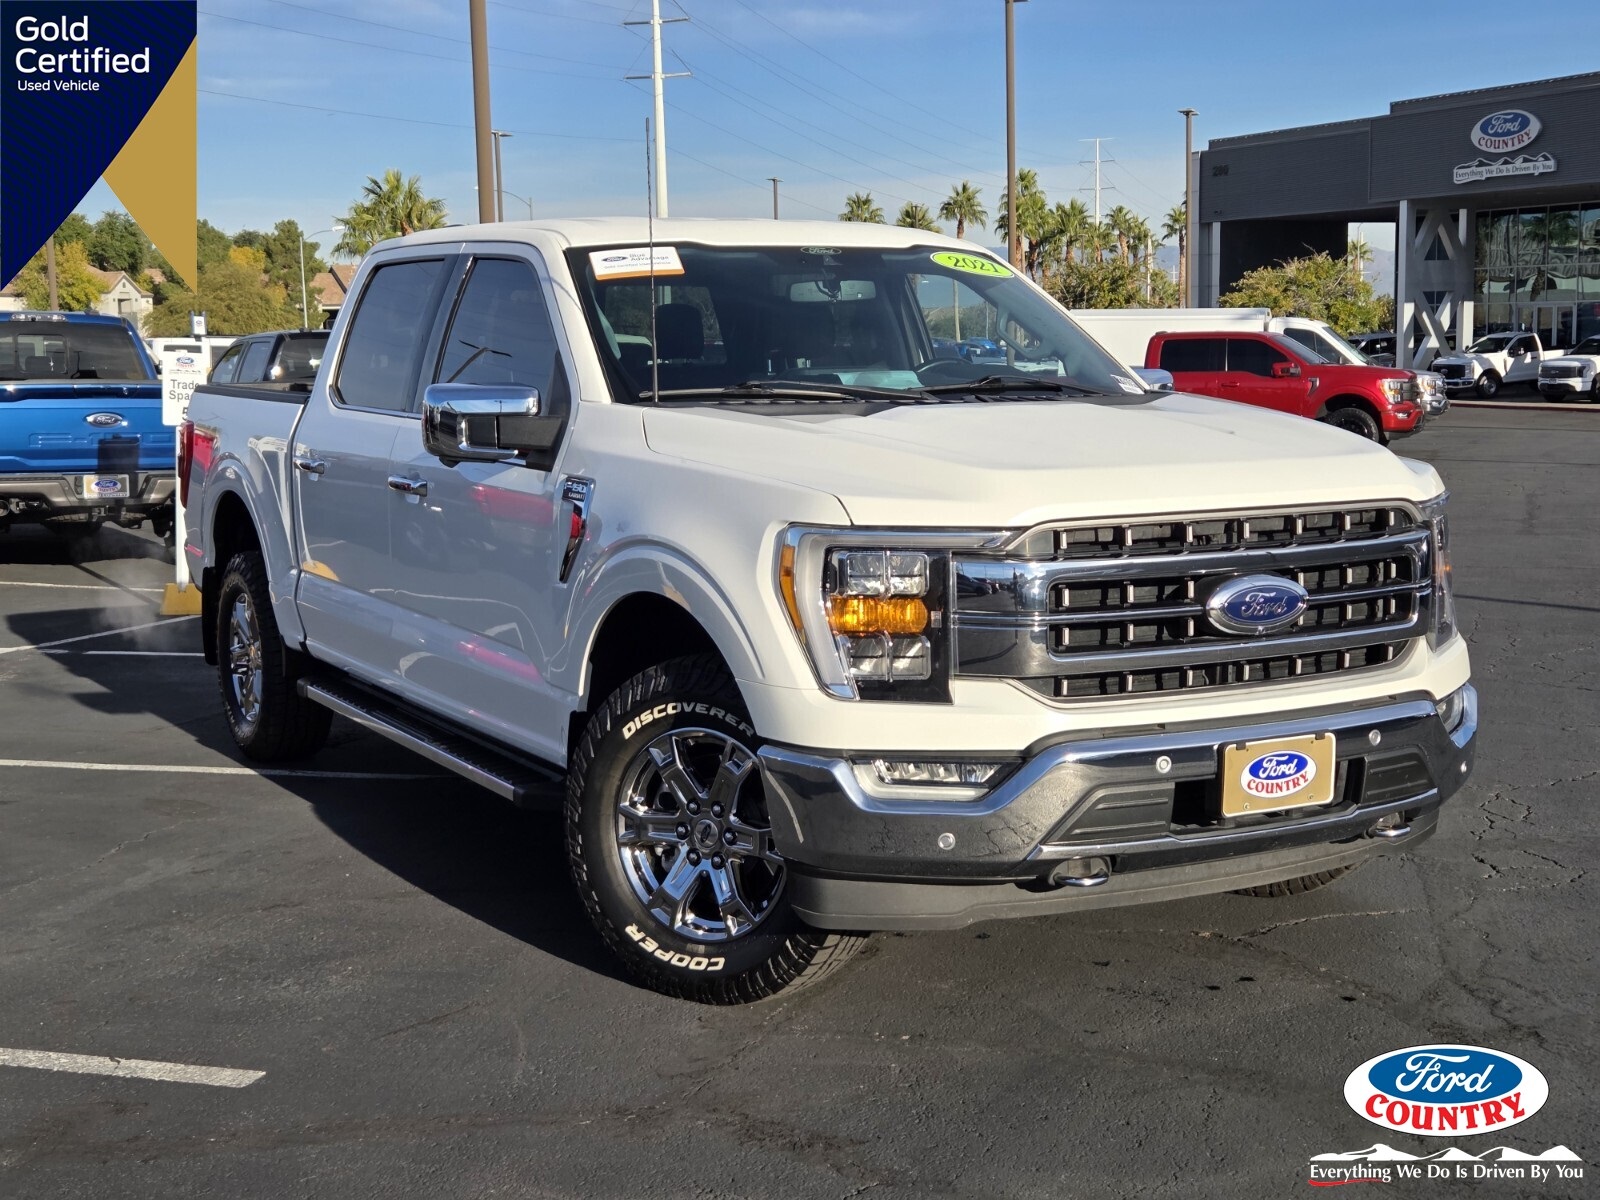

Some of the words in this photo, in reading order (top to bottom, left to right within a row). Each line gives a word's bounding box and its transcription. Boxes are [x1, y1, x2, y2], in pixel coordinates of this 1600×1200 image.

[1488, 114, 1522, 134] Ford
[1478, 129, 1532, 150] COUNTRY
[1455, 169, 1484, 179] Everything
[1485, 168, 1495, 176] We
[1512, 164, 1531, 172] Driven
[1532, 163, 1540, 173] By
[1541, 162, 1553, 171] You
[947, 255, 1002, 274] 2021
[170, 379, 199, 390] Trade
[169, 390, 191, 402] Spa
[1241, 591, 1288, 617] Ford
[622, 701, 755, 740] DISCOVERER
[1259, 755, 1298, 778] Ford
[1247, 771, 1309, 794] COUNTRY
[624, 923, 726, 971] COOPER
